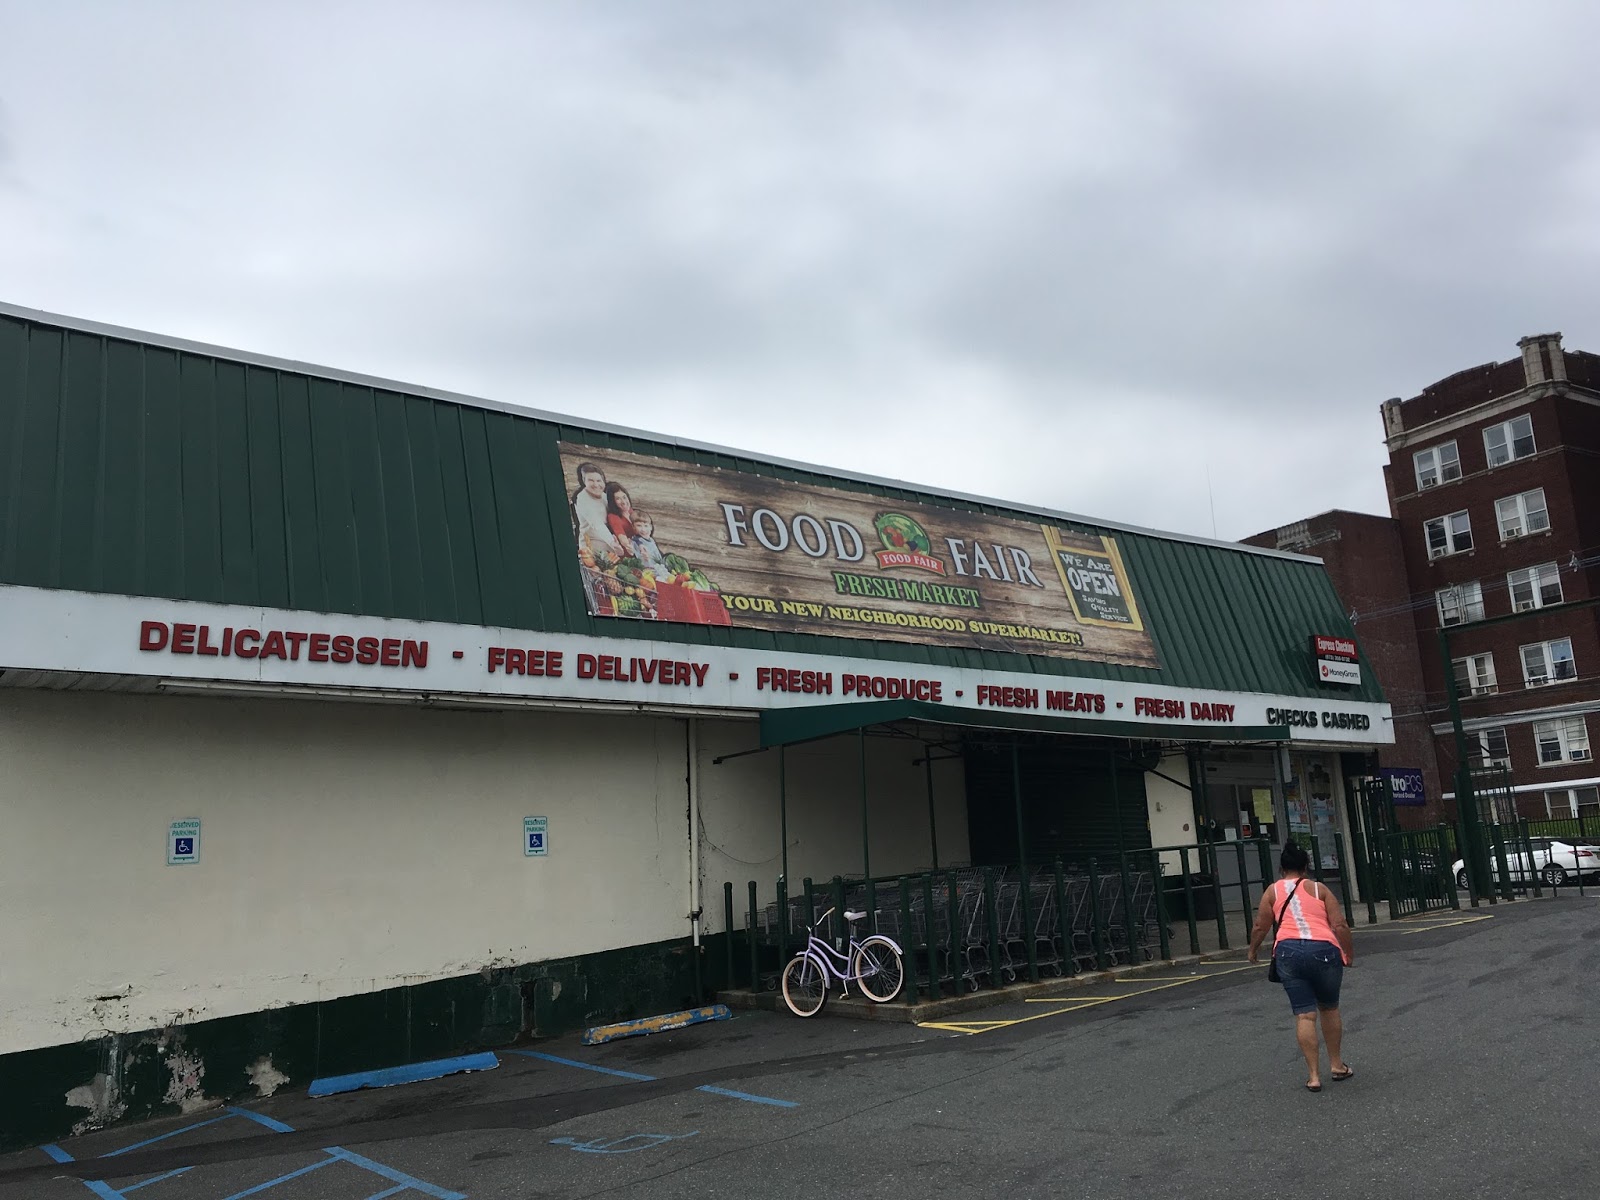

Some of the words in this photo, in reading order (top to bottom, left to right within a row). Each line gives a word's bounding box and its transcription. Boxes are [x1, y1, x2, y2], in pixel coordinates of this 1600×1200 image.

[719, 502, 864, 562] FOOD
[944, 537, 1045, 588] FAIR
[882, 554, 911, 564] FOOD
[913, 555, 938, 569] FAIR
[833, 572, 899, 600] FRESH
[902, 580, 980, 608] MARKET
[1067, 567, 1121, 597] OPEN
[721, 594, 778, 614] YOUR
[782, 602, 824, 618] NEW
[828, 605, 966, 632] NEIGHBORHOOD
[969, 620, 1083, 646] SUPERMARKET!
[139, 620, 428, 668] DELICATESSEN
[488, 647, 563, 677] FREE
[577, 653, 709, 687] DELIVERY
[1329, 668, 1359, 678] MoneyGram
[757, 667, 832, 695] FRESH
[842, 673, 943, 702] PRODUCE
[977, 685, 1038, 709] FRESH
[1046, 690, 1106, 714] MEATS
[1134, 696, 1185, 719] FRESH
[1191, 702, 1235, 722] DAIRY
[1266, 707, 1318, 728] CHECKS
[1321, 711, 1370, 731] CASHED
[1391, 774, 1424, 792] troPCS
